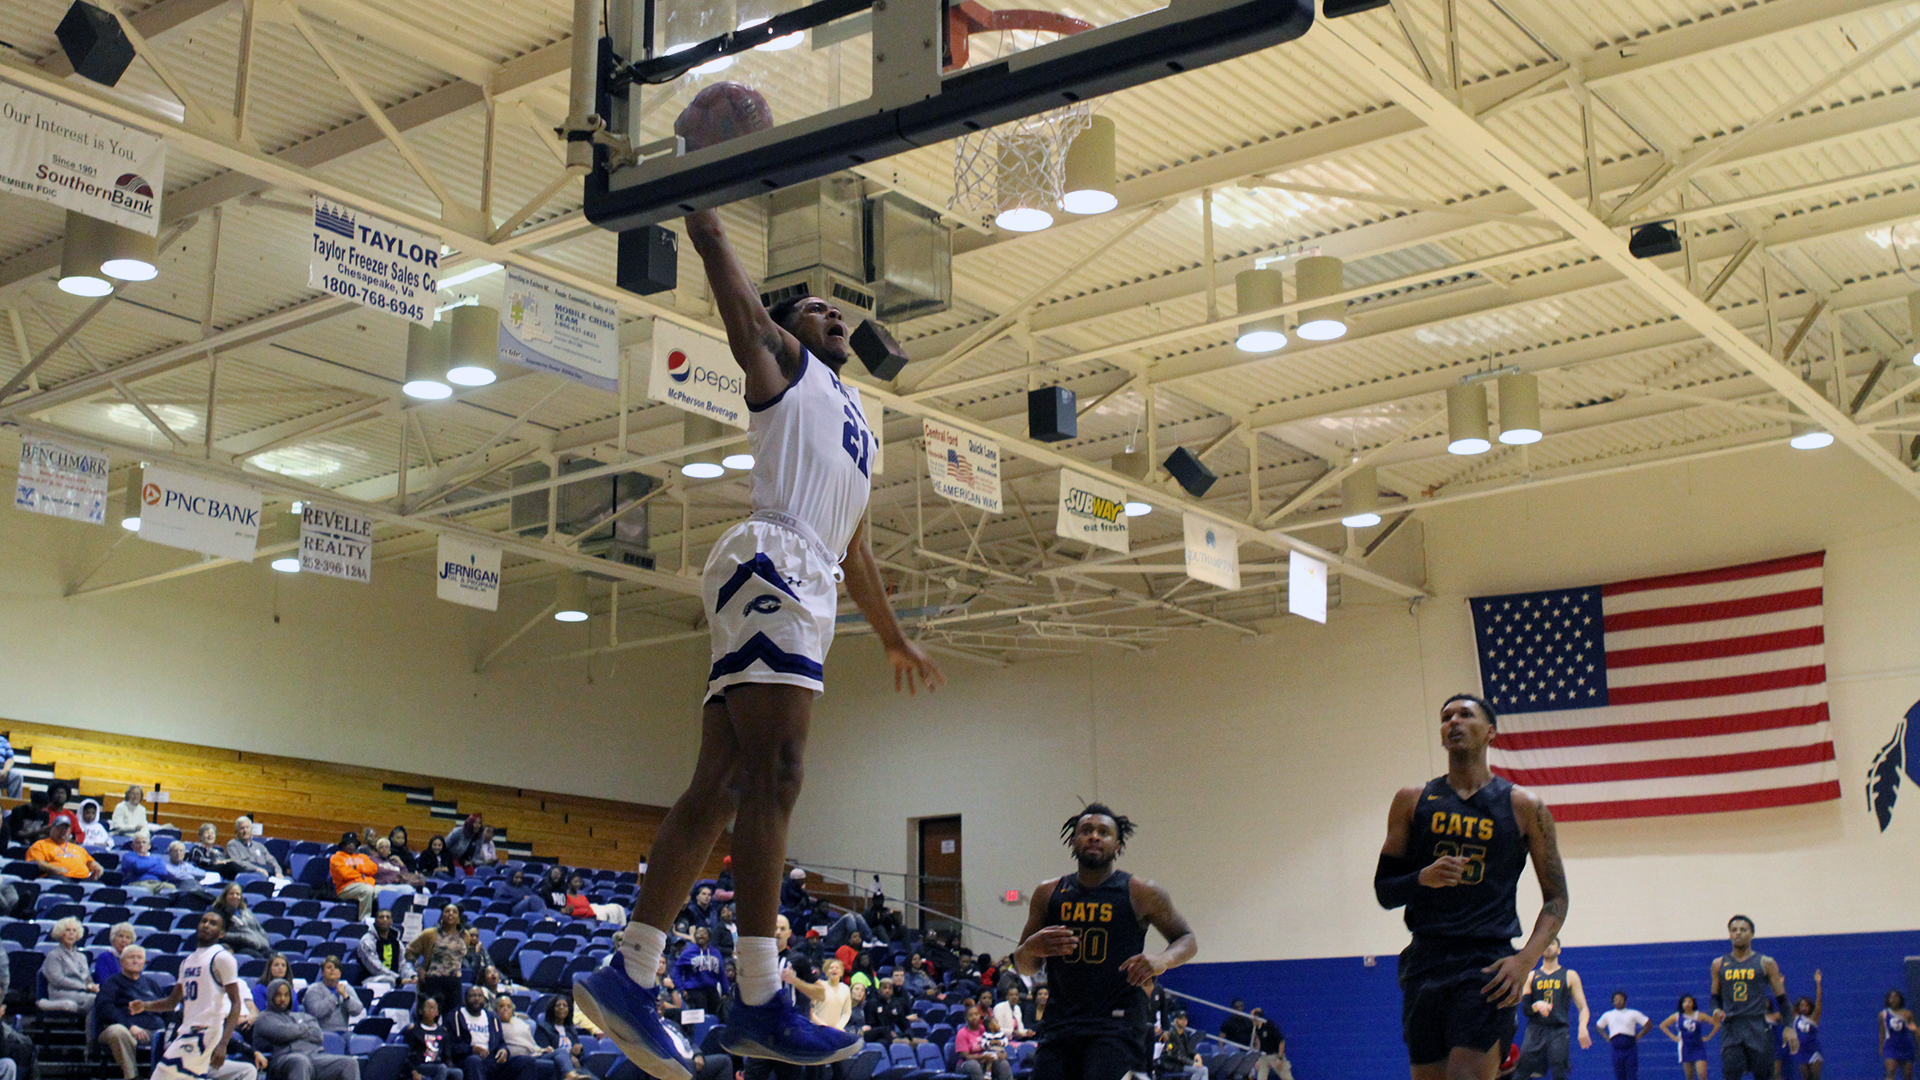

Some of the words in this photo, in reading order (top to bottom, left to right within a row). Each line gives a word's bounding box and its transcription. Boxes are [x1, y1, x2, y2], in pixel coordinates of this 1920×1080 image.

[3, 102, 31, 125] Our
[35, 113, 89, 148] Interest
[93, 134, 105, 150] is
[108, 138, 138, 164] You.
[52, 154, 76, 170] Since
[78, 163, 98, 177] 1901
[35, 163, 153, 215] SouthernBank
[36, 186, 57, 198] FDIC
[313, 232, 346, 262] Taylor
[348, 246, 389, 277] Freezer
[390, 261, 420, 289] Sales
[358, 224, 438, 269] TAYLOR
[337, 262, 399, 296] Chesapeake,
[401, 284, 415, 298] Va
[322, 274, 424, 321] 1800-768-6945
[554, 303, 587, 320] MOBILE
[588, 314, 615, 331] CRISIS
[554, 312, 579, 325] TEAM
[693, 366, 742, 395] pepsi
[667, 387, 705, 408] McPherson
[705, 400, 739, 421] Beverage
[842, 404, 869, 480] 21
[21, 442, 106, 476] BENCHMARK
[982, 495, 998, 510] WAY
[1064, 487, 1125, 523] SUBWAY
[303, 507, 371, 538] REVELLE
[1083, 524, 1098, 532] eat
[304, 536, 367, 560] REALTY
[439, 561, 499, 584] JERNIGAN
[1430, 811, 1494, 841] CATS
[1061, 902, 1113, 922] CATS
[1536, 979, 1561, 990] CATS
[1725, 969, 1755, 980] CATS
[1733, 981, 1748, 1002] 2
